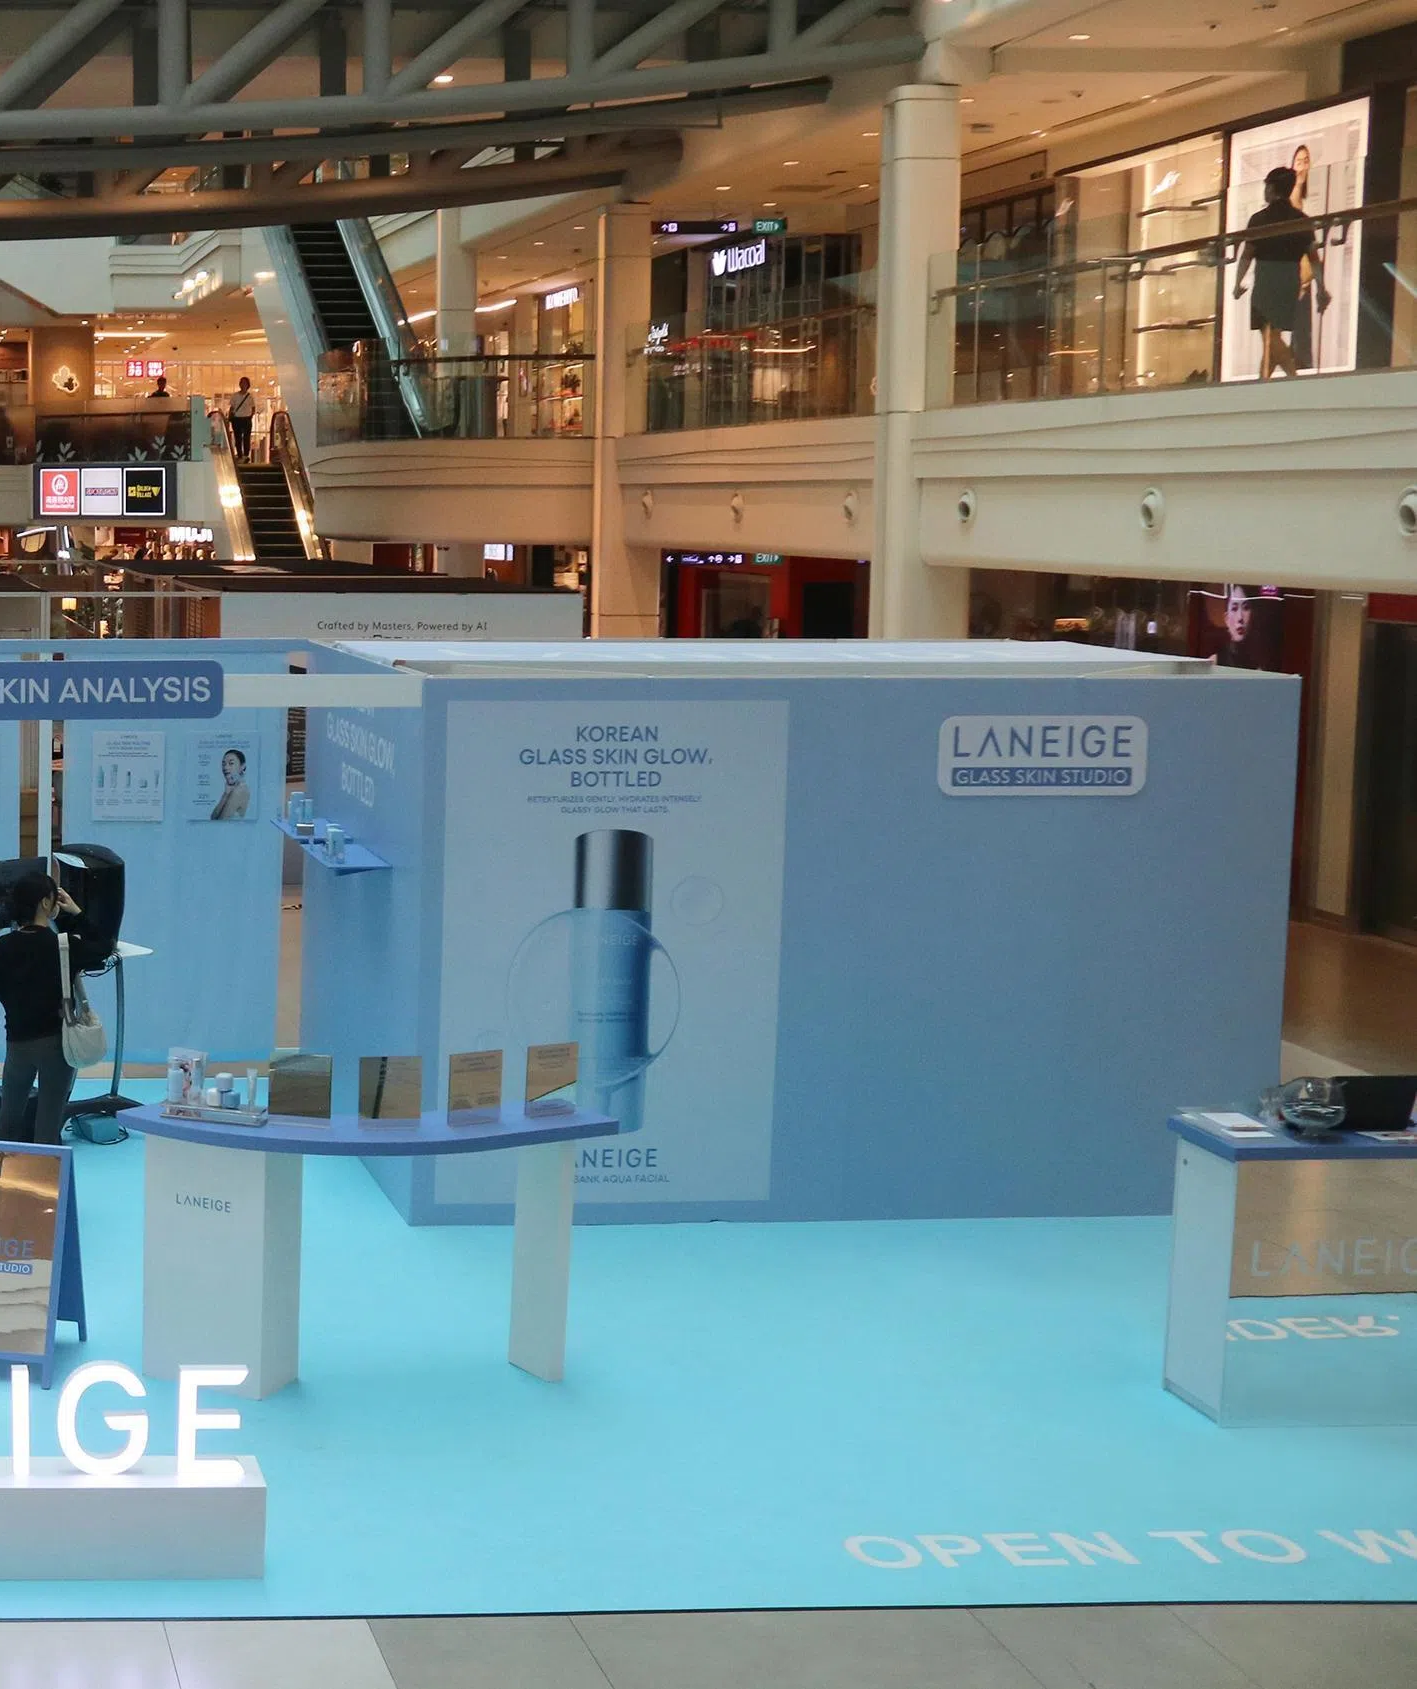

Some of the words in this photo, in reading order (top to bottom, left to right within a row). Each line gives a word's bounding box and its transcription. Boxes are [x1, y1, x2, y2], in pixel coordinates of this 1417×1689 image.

[755, 221, 775, 232] EXIT
[727, 239, 766, 273] Wacoal
[169, 526, 213, 542] MUJI
[317, 620, 354, 631] Crafted
[357, 621, 369, 633] by
[372, 621, 414, 633] Masters,
[417, 620, 459, 631] Powered
[461, 621, 473, 633] by
[58, 675, 212, 704] ANALYSIS
[326, 711, 350, 748] GLASS
[576, 726, 659, 742] KOREAN
[953, 725, 1134, 758] LANEIGE
[518, 748, 587, 765] GLASS
[592, 748, 638, 765] SKIN
[644, 747, 714, 765] GLOW,
[341, 761, 375, 808] BOTTLED
[570, 770, 662, 787] BOTTLED
[955, 769, 1011, 785] GLASS
[1015, 769, 1056, 785] SKIN
[1061, 769, 1128, 785] STUDIO
[594, 805, 618, 814] GLOW
[620, 805, 641, 814] THAT
[573, 1148, 659, 1168] NEIGE
[602, 1174, 632, 1184] AQUA
[634, 1173, 670, 1183] FACIAL
[175, 1193, 232, 1213] LANEIGE
[842, 1531, 1142, 1569] OPEN
[1147, 1528, 1308, 1565] TO
